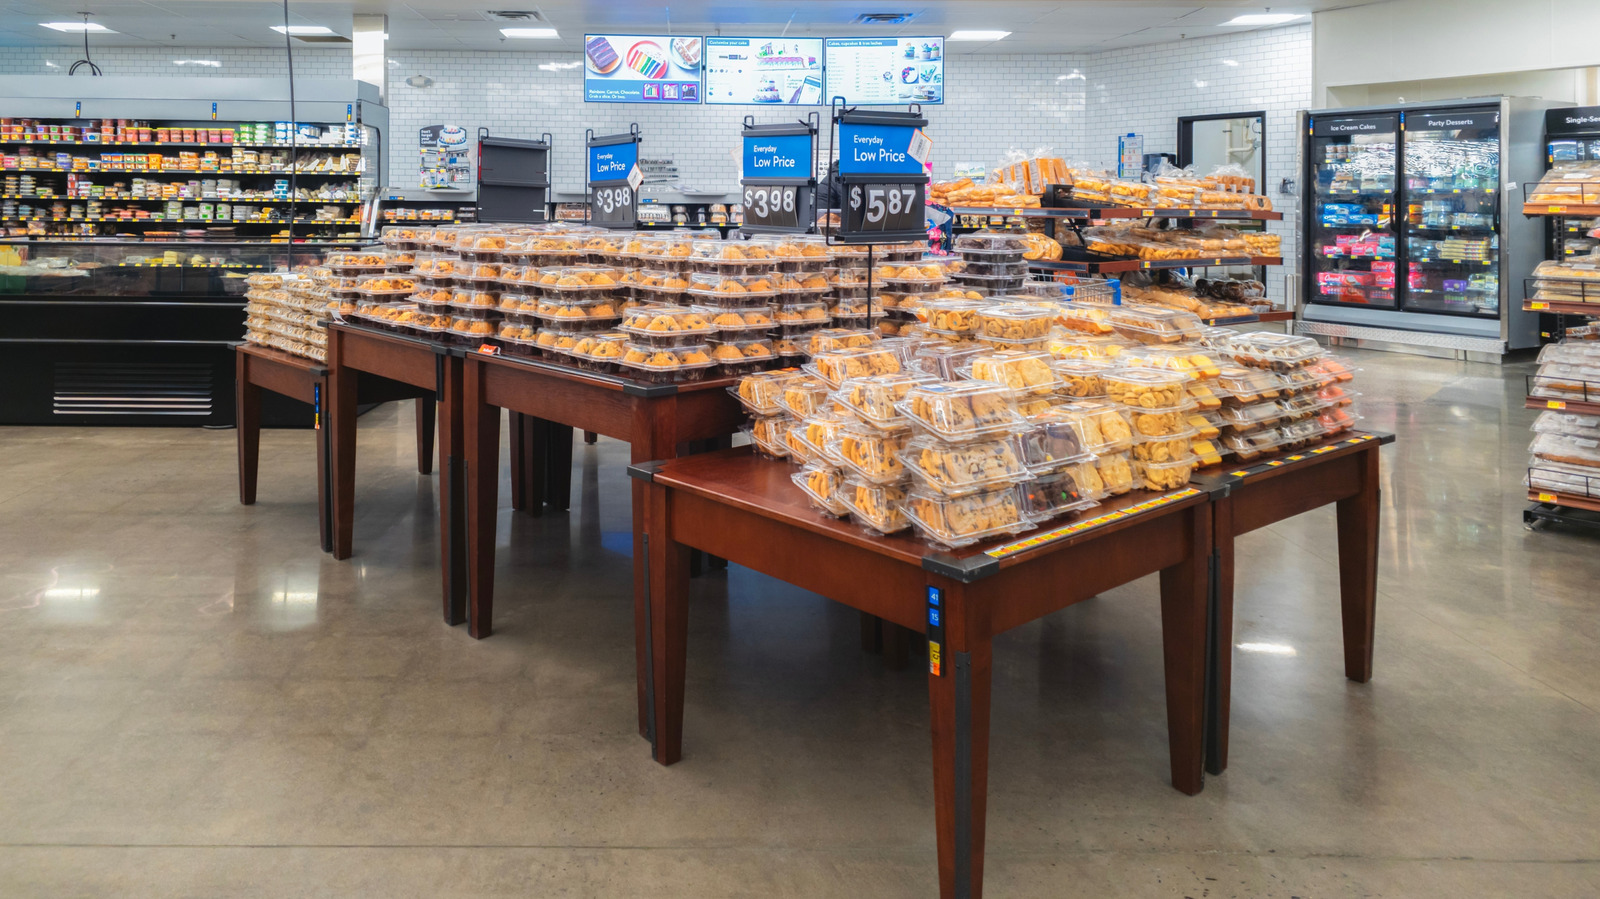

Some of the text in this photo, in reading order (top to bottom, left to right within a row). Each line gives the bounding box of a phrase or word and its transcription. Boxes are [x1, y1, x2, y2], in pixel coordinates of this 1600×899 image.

[853, 135, 883, 146] Everyday
[753, 145, 777, 154] Everyday
[854, 148, 876, 162] Low
[879, 149, 905, 162] Price
[597, 161, 626, 172] Low Price
[754, 156, 795, 168] Low Price
